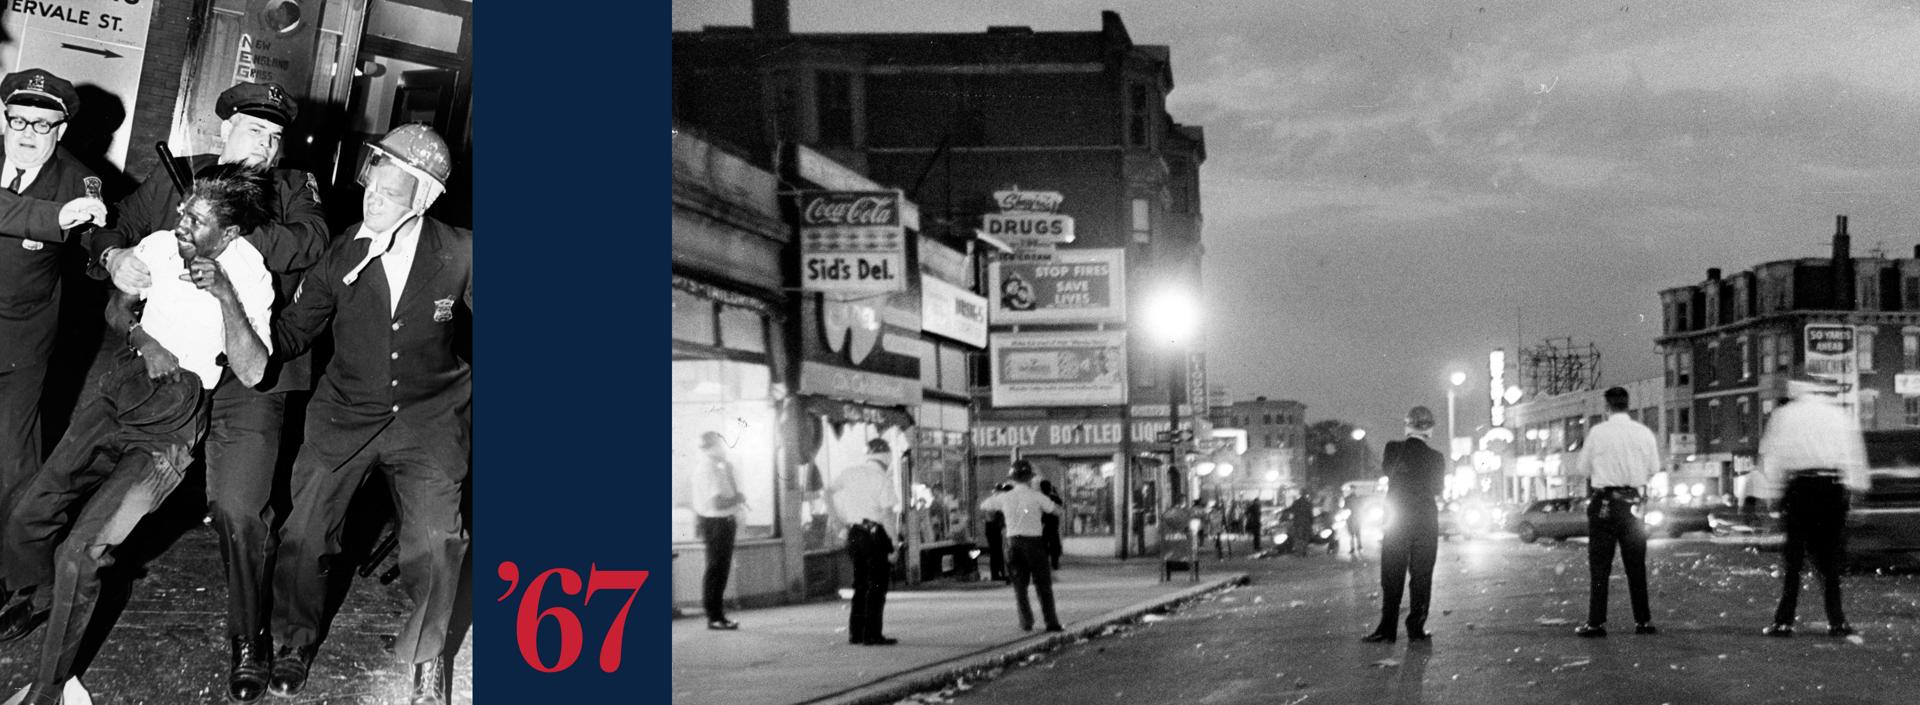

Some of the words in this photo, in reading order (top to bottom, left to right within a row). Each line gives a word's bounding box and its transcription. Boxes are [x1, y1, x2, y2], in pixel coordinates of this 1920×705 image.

[98, 13, 123, 32] ST.
[805, 196, 892, 225] Coca-Cola
[989, 219, 1063, 235] DRUGS
[808, 258, 850, 280] Sid's
[858, 258, 894, 280] Del.
[1035, 266, 1069, 278] STOP
[1073, 265, 1109, 277] FIRES
[1056, 280, 1089, 293] SAVE
[1054, 293, 1090, 305] LIVES
[1816, 342, 1844, 351] AHEAD
[1050, 422, 1122, 445] BOTTLED
